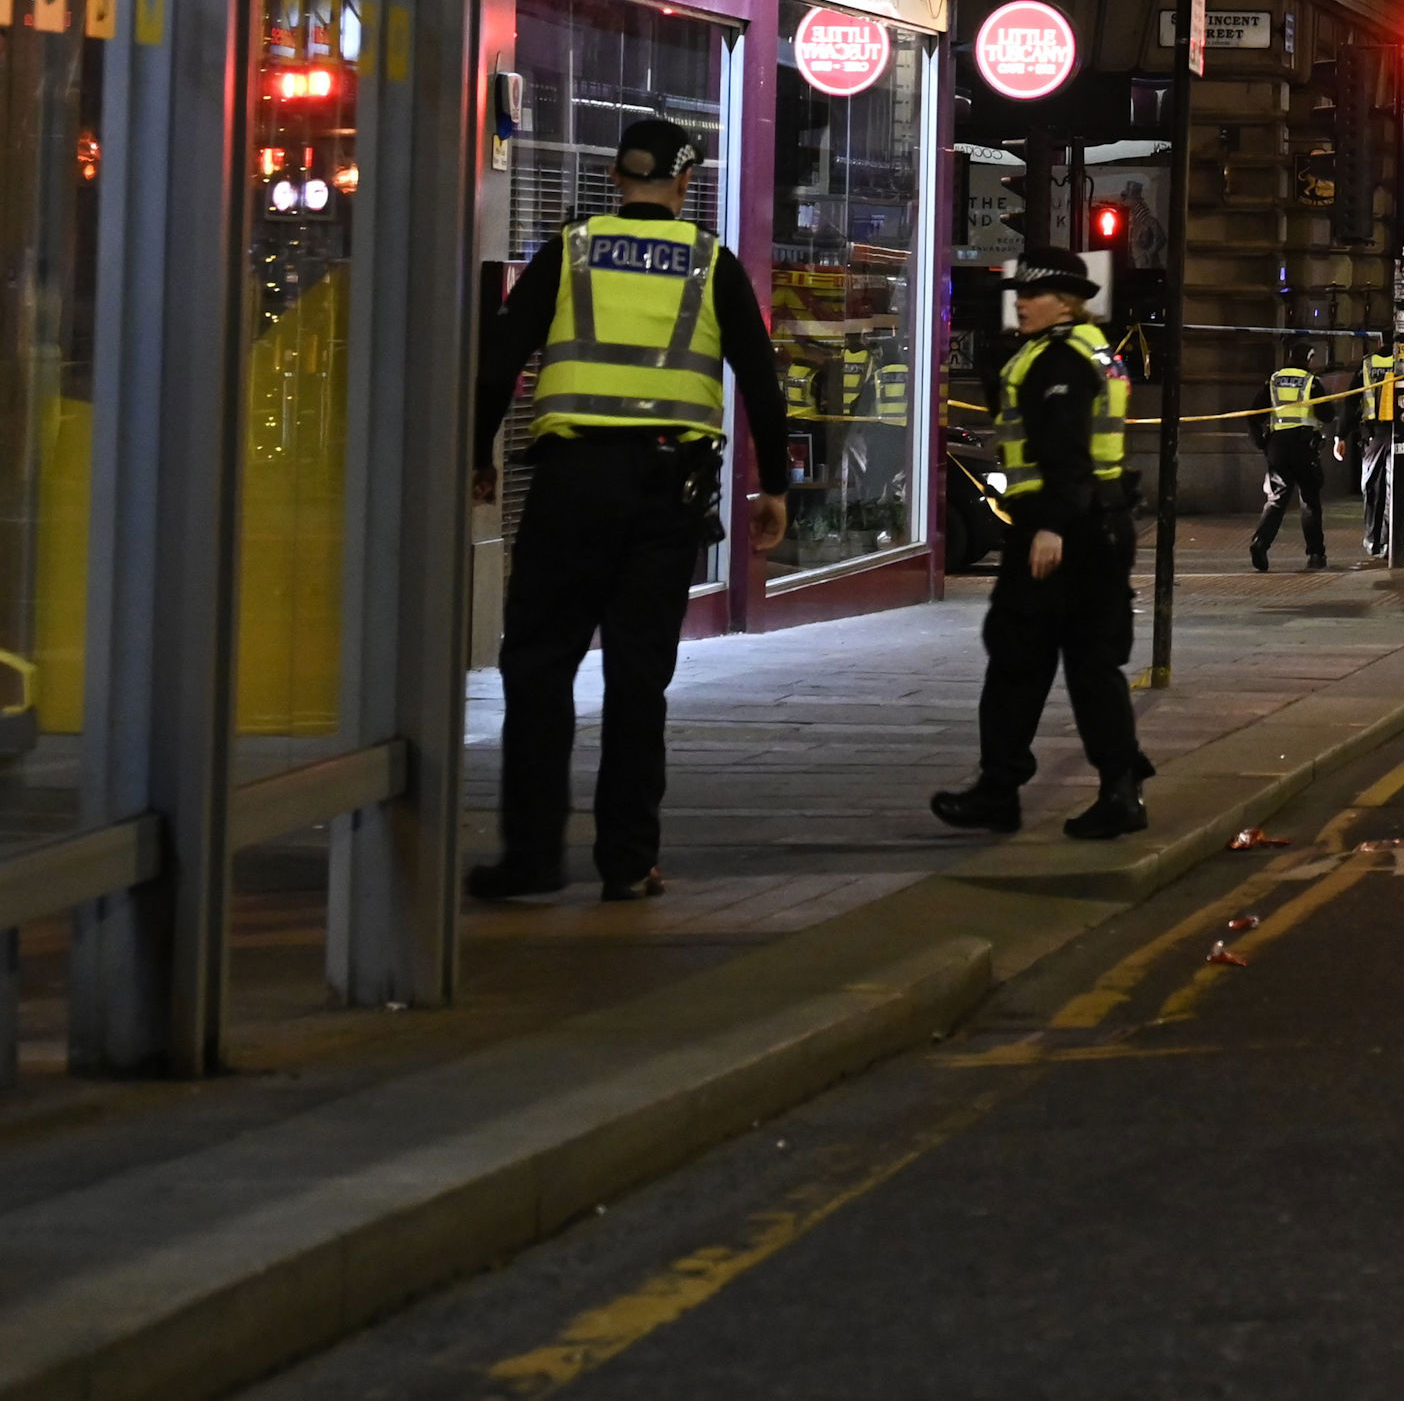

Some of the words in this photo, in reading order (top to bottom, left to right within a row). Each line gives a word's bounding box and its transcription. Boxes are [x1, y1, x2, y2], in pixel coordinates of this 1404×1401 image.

[1206, 14, 1260, 27] INCENT
[997, 28, 1057, 45] LITTLE
[1206, 29, 1245, 39] REET
[987, 44, 1069, 64] TUSCANY
[592, 240, 687, 272] POLICE
[1276, 376, 1304, 388] POLICE
